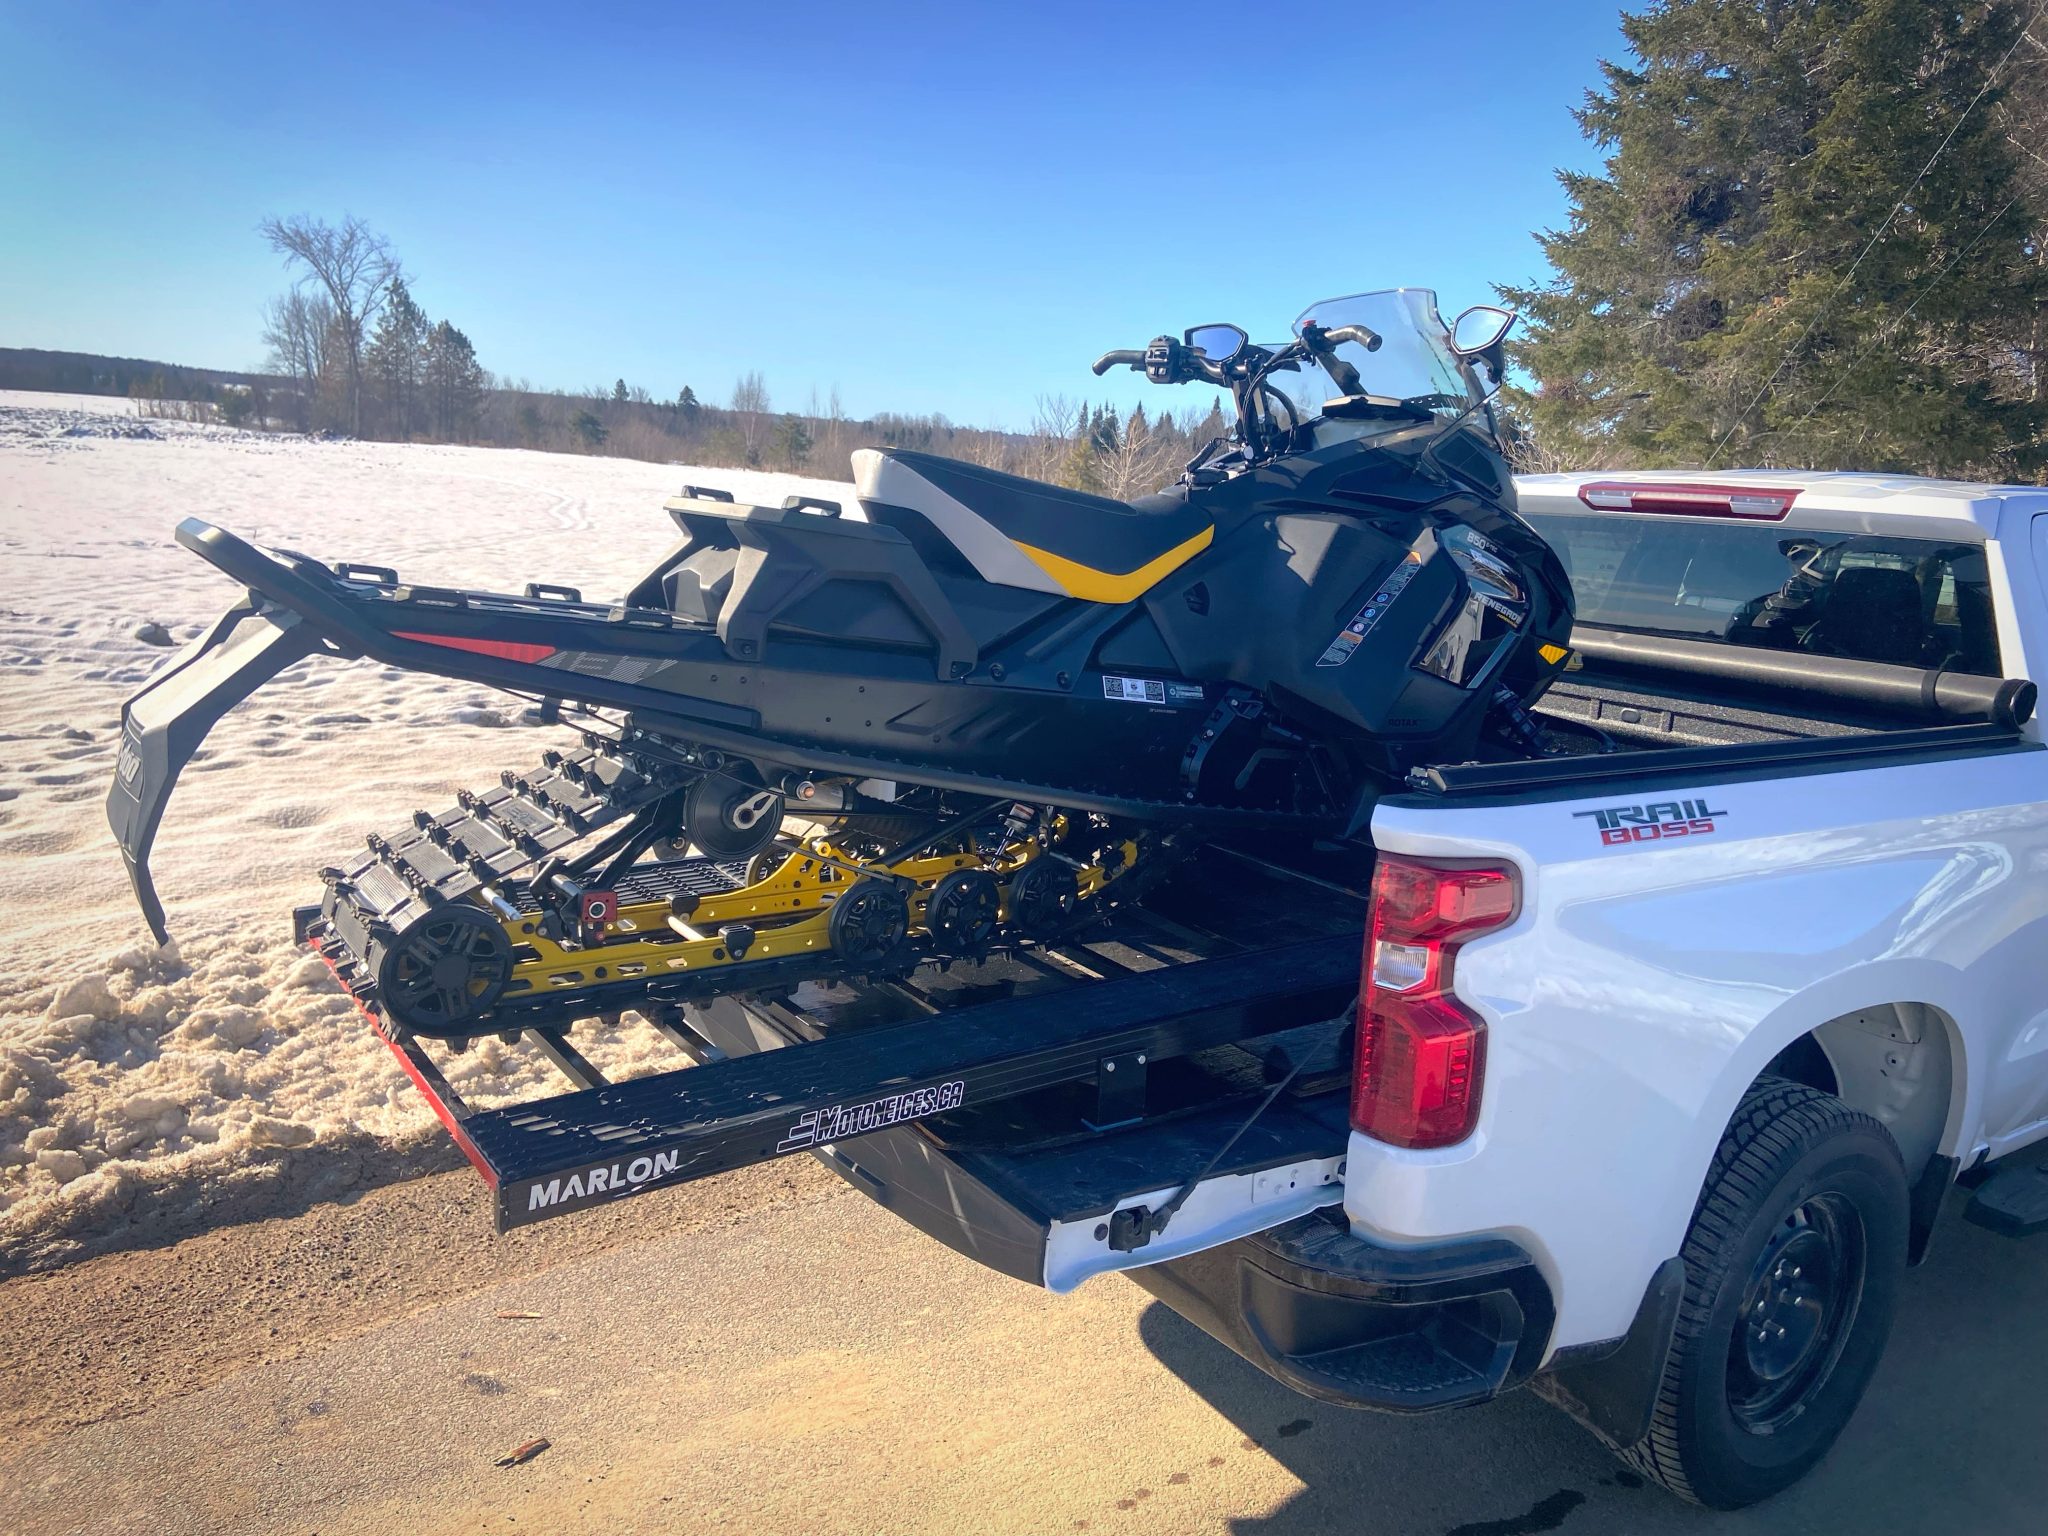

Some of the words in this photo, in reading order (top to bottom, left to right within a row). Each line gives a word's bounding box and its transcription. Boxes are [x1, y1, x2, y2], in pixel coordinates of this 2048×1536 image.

[1467, 531, 1487, 550] 850
[1572, 798, 1728, 829] TRAIL
[1600, 818, 1715, 846] BOSS
[814, 1081, 964, 1142] MOTONEIGES.CA
[528, 1149, 679, 1211] MARLON
